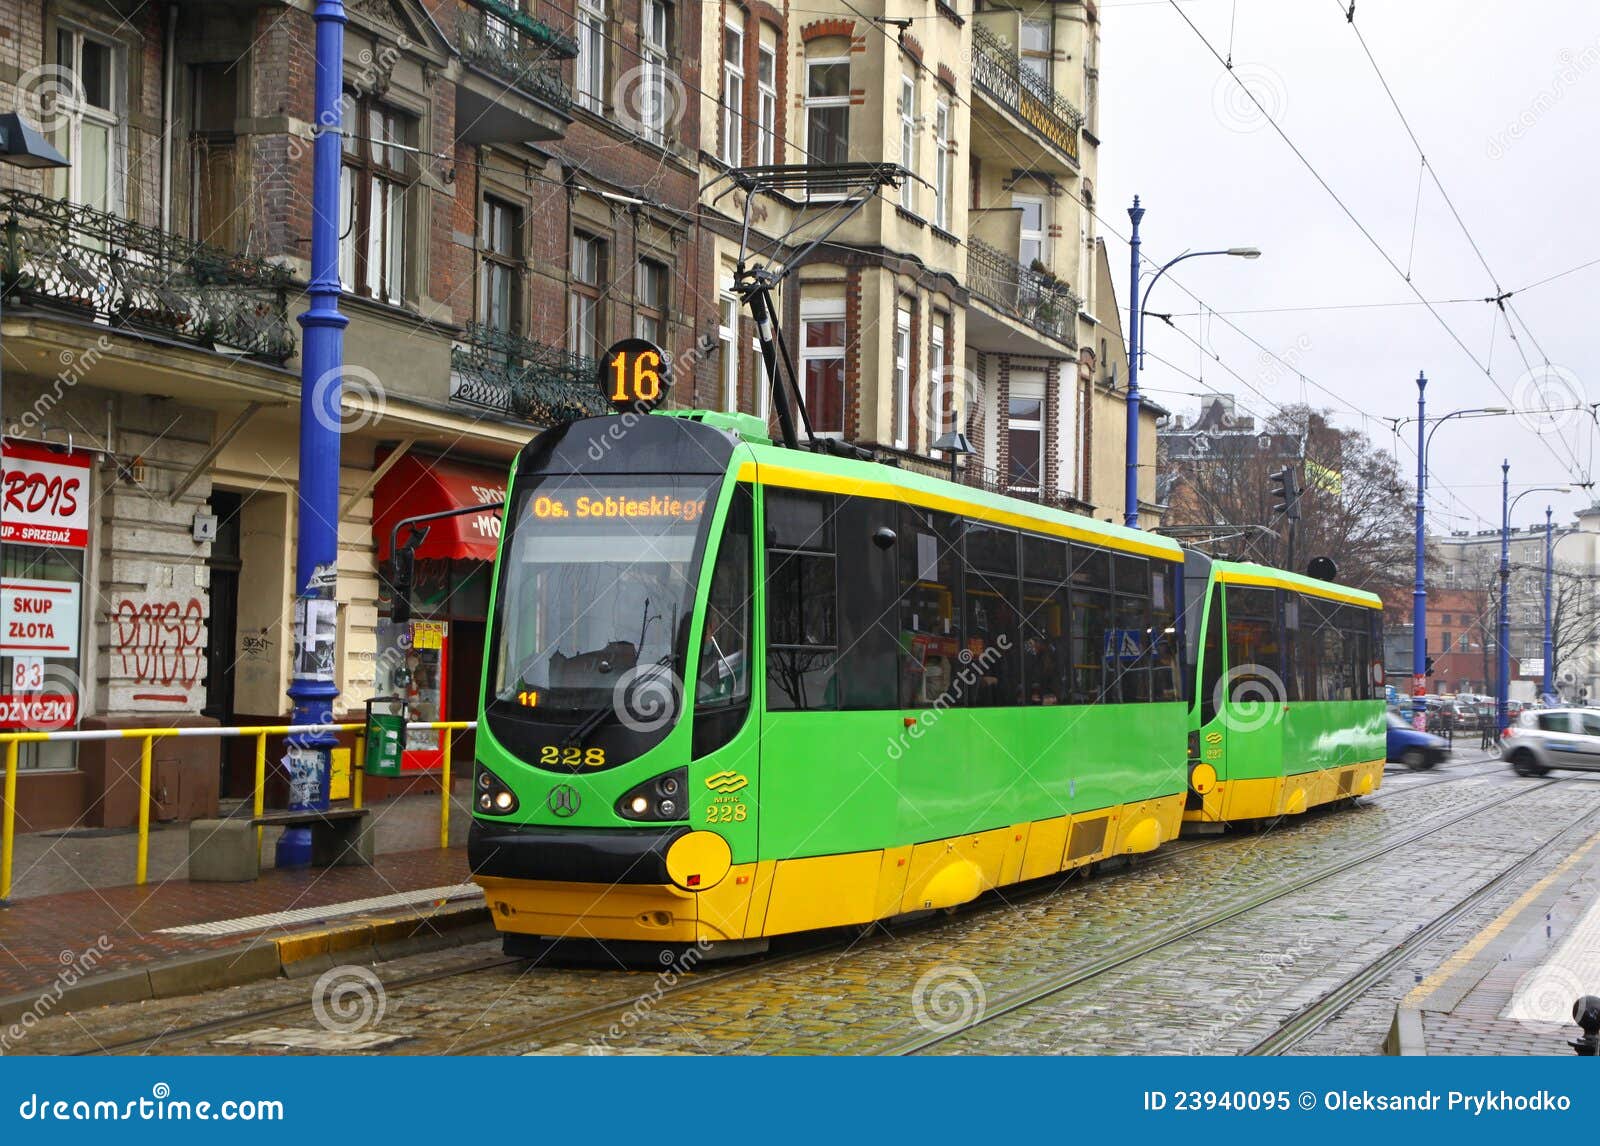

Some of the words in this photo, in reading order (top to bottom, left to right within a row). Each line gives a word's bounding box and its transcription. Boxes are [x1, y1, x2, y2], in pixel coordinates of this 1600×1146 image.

[611, 351, 660, 401] 16
[0, 468, 80, 517] RDIS
[534, 496, 569, 517] Os.
[21, 527, 71, 543] SPRZEDAŻ
[201, 523, 208, 533] 4
[13, 597, 53, 614] SKUP
[8, 621, 55, 639] ZŁOTA
[518, 691, 538, 707] 11
[540, 745, 605, 766] 228
[706, 804, 747, 824] 228
